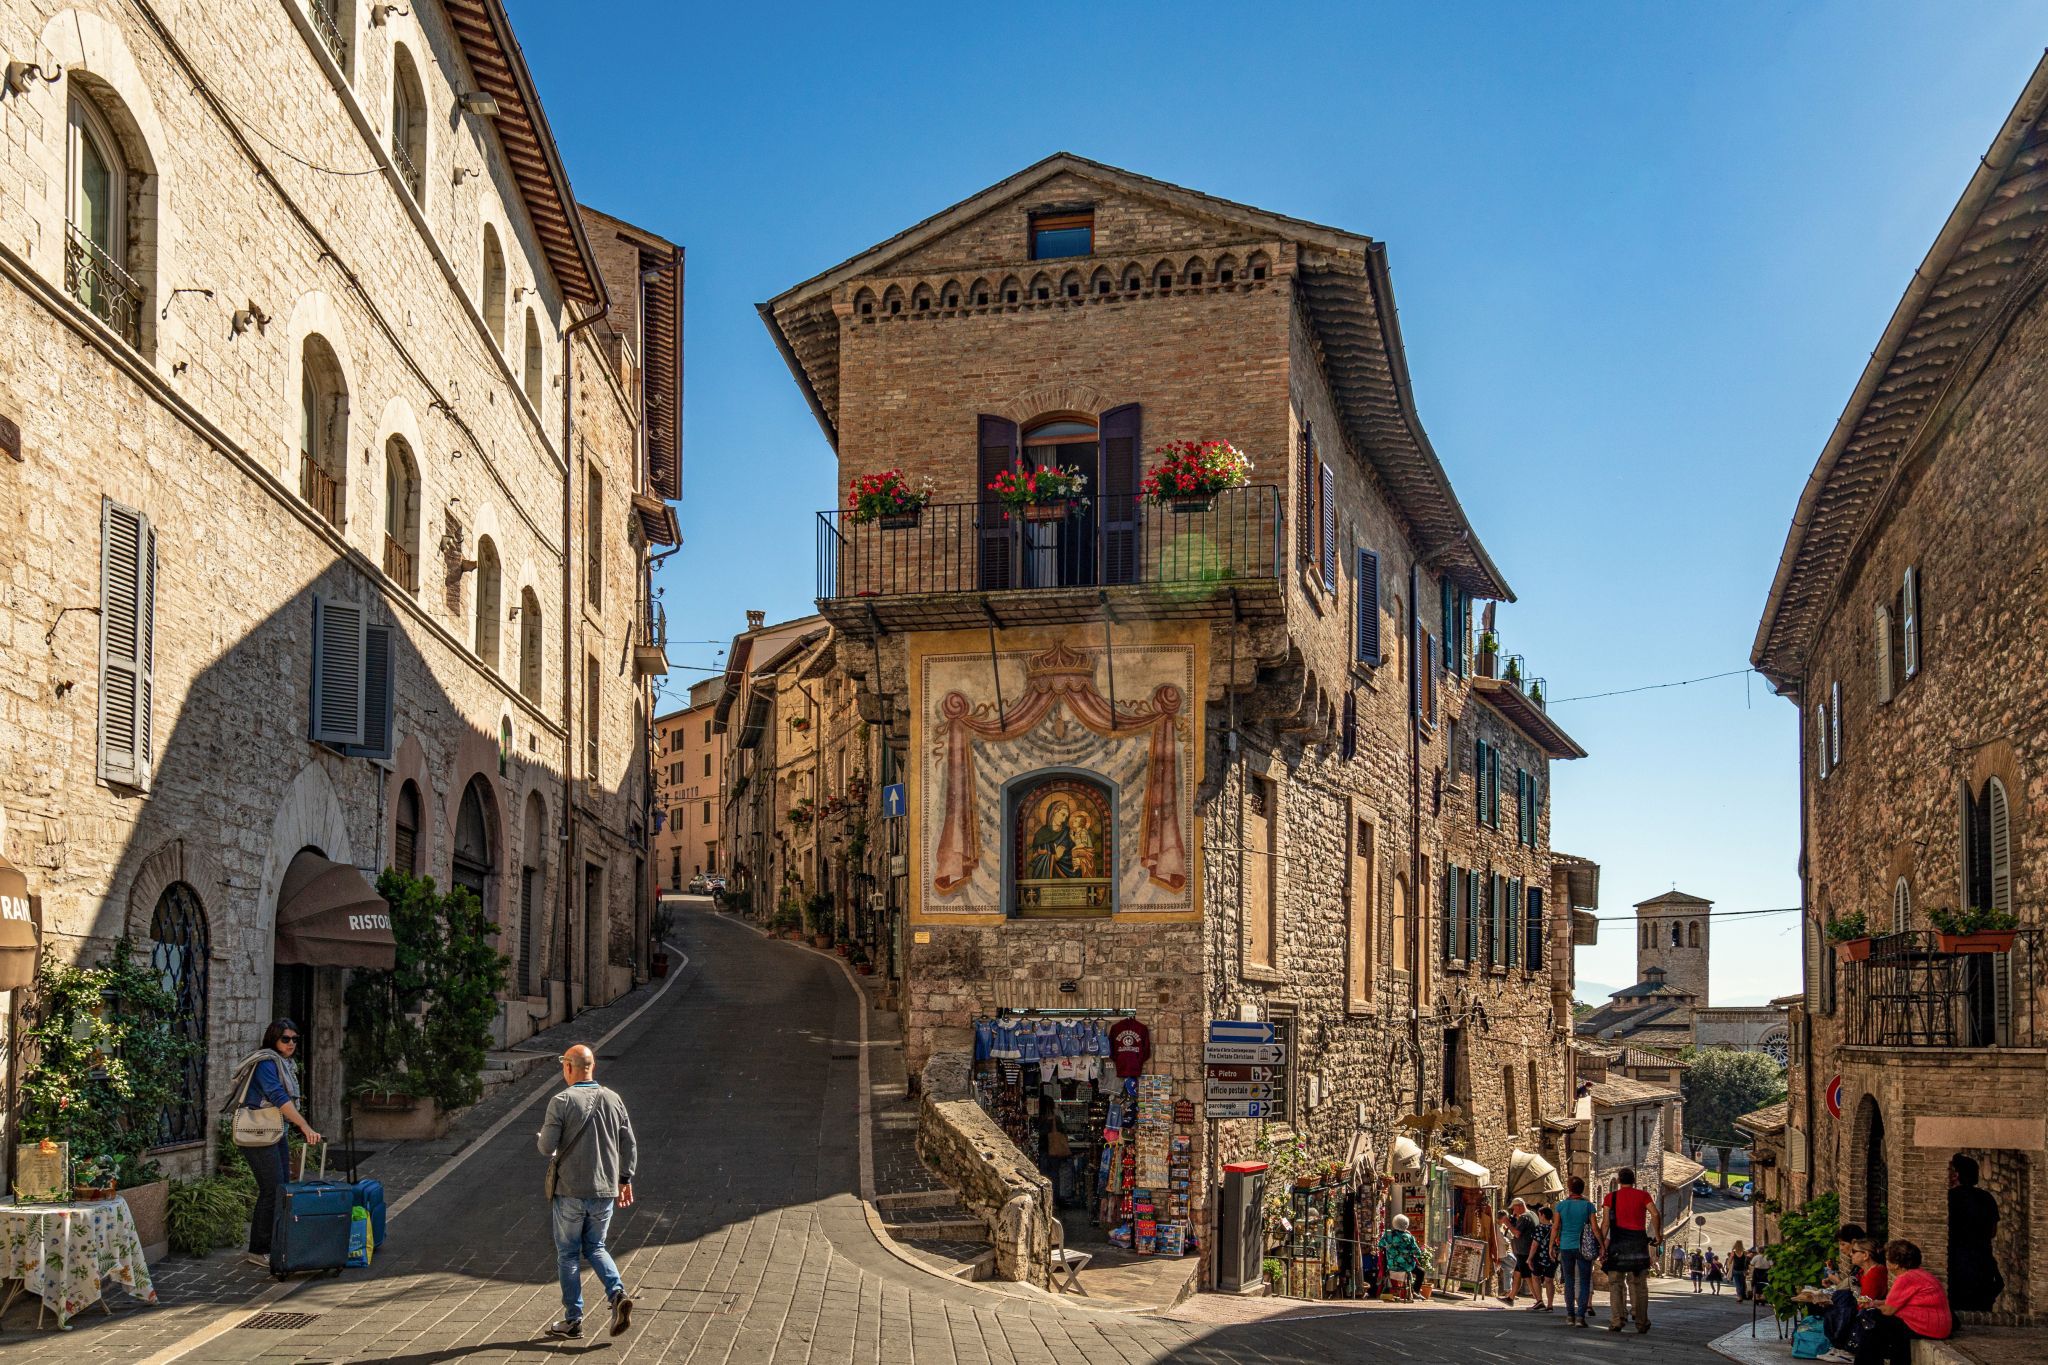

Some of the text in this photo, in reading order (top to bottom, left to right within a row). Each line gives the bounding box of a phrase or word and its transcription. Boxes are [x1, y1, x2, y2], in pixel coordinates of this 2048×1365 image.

[1210, 1086, 1248, 1095] ufficio postale
[1394, 1172, 1412, 1184] BAR
